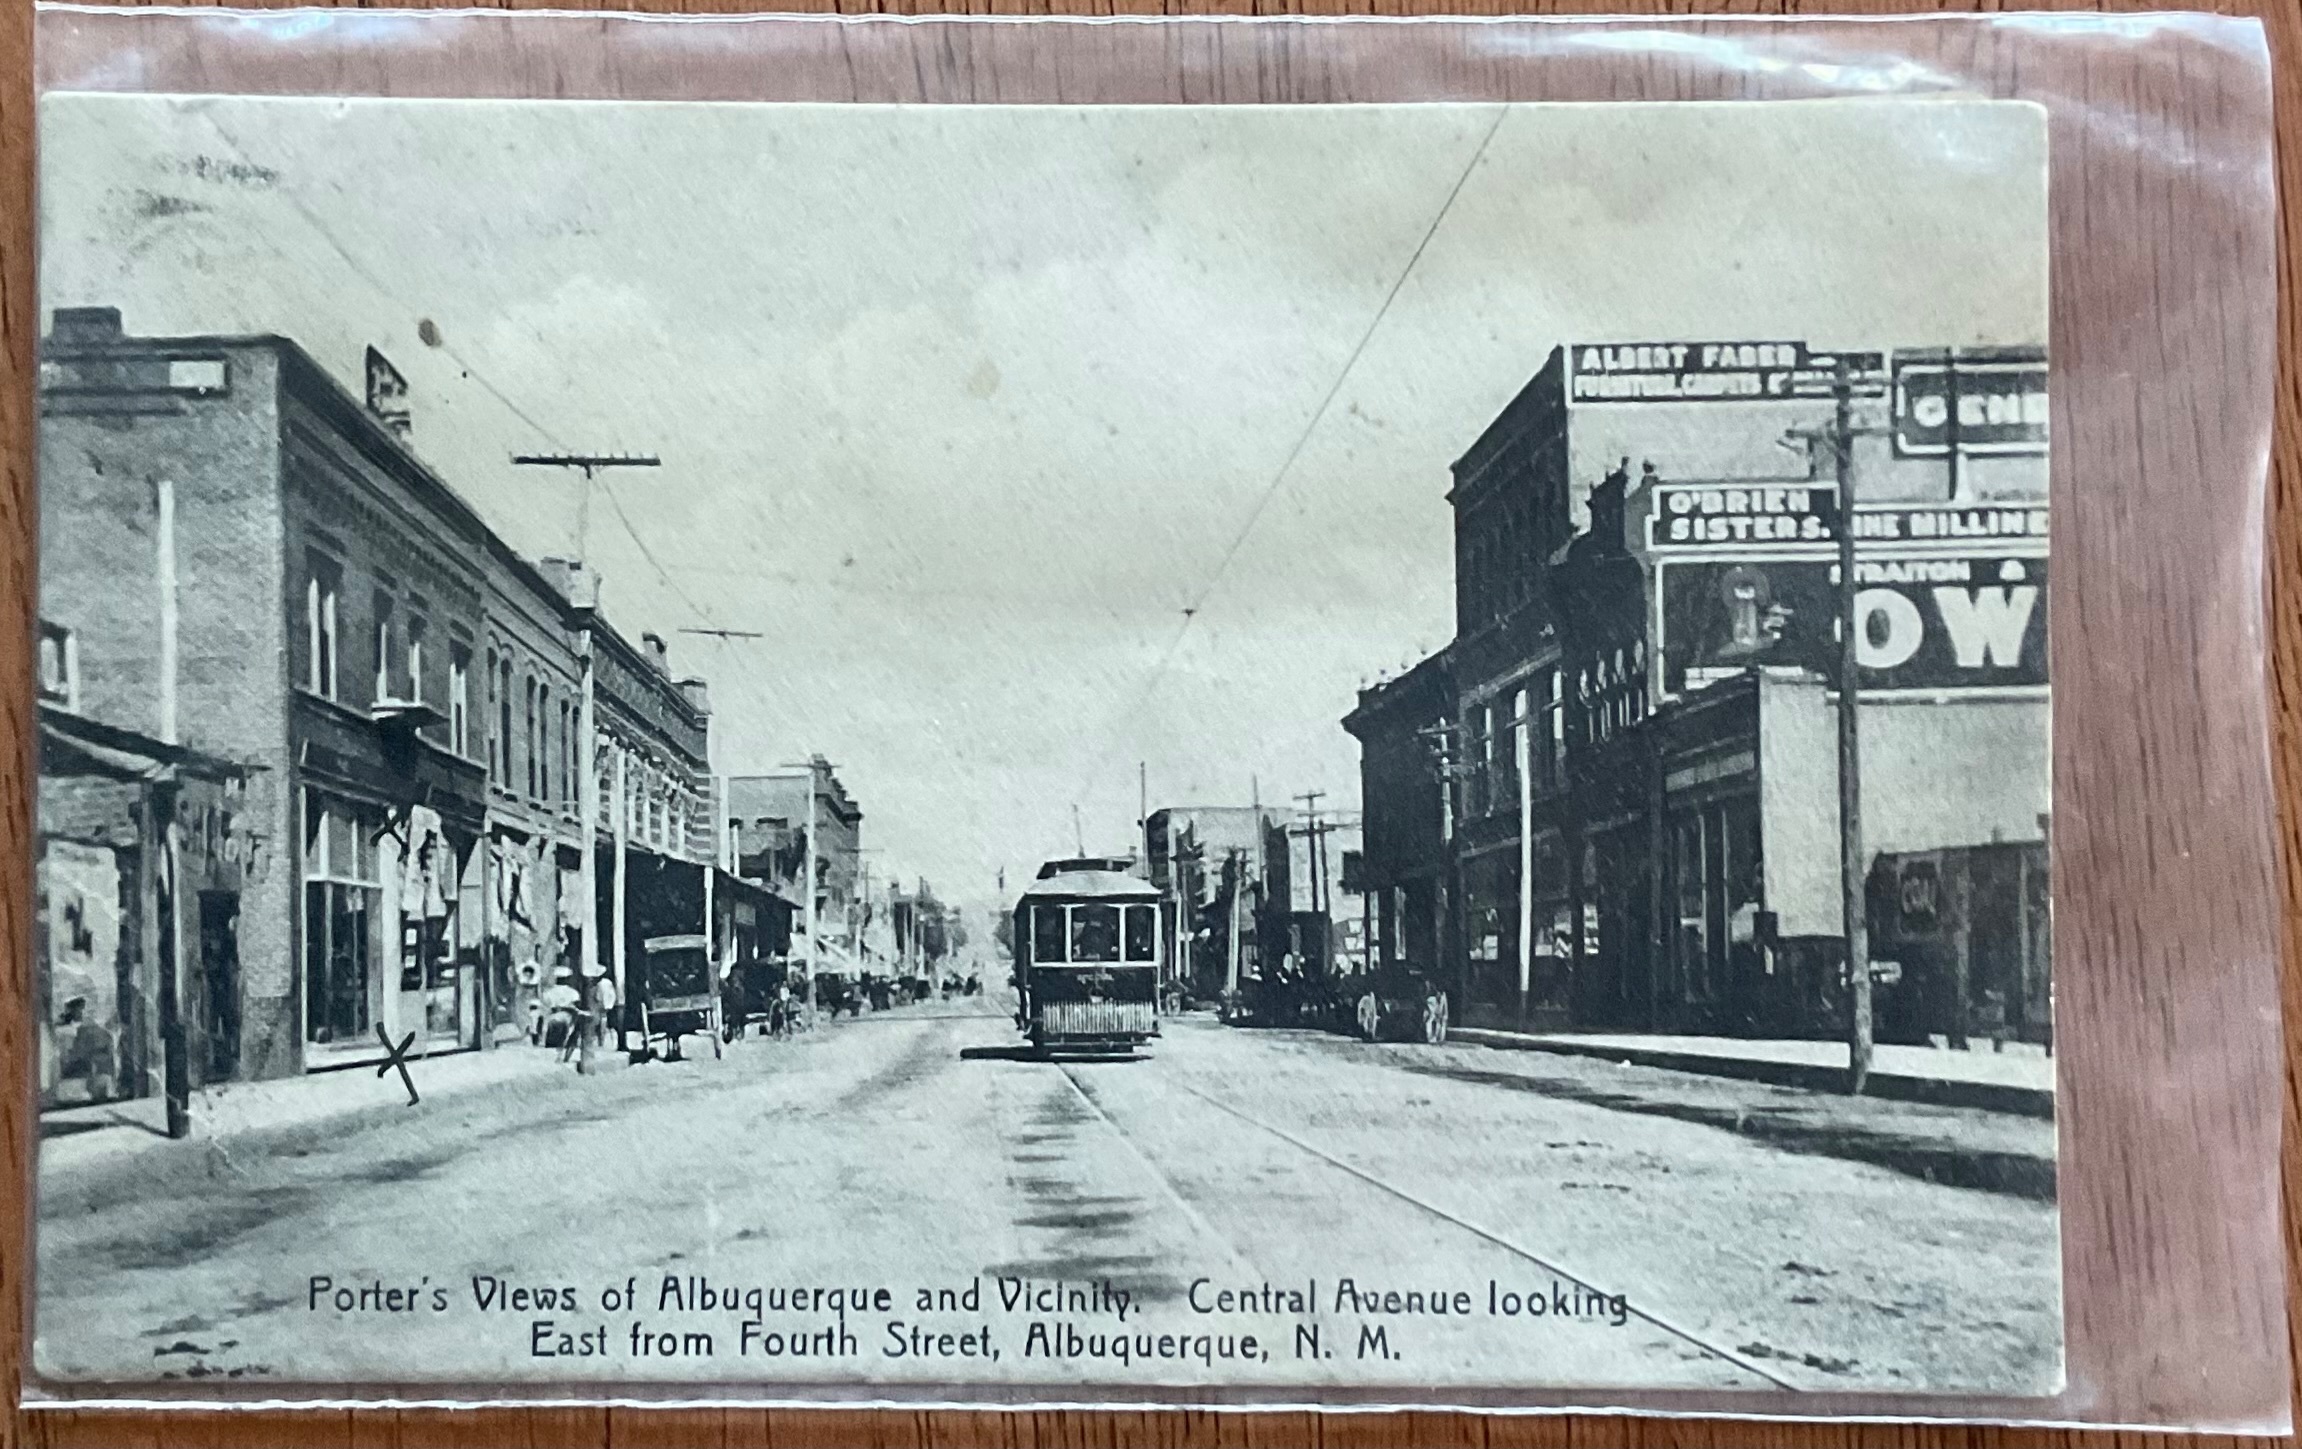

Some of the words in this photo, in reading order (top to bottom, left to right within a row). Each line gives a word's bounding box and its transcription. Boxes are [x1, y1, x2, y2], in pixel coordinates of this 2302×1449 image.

[1668, 489, 1811, 515] O'BRIEN
[1670, 515, 1831, 541] SISTERS.
[307, 1275, 449, 1313] Porter's
[472, 1276, 578, 1312] Views
[600, 1276, 637, 1312] of
[657, 1275, 893, 1322] Albuquerque
[915, 1275, 980, 1313] and
[999, 1275, 1142, 1321] Vicinity.
[1189, 1278, 1317, 1315] Central
[1334, 1279, 1472, 1315] Avenue
[1489, 1279, 1628, 1326] looking
[530, 1321, 608, 1358] East
[629, 1321, 714, 1358] from
[739, 1320, 859, 1357] Fourth
[881, 1320, 1003, 1361] Street,
[1024, 1323, 1269, 1367] Albuquerque,
[1294, 1323, 1334, 1360] N.
[1357, 1325, 1402, 1361] M.
